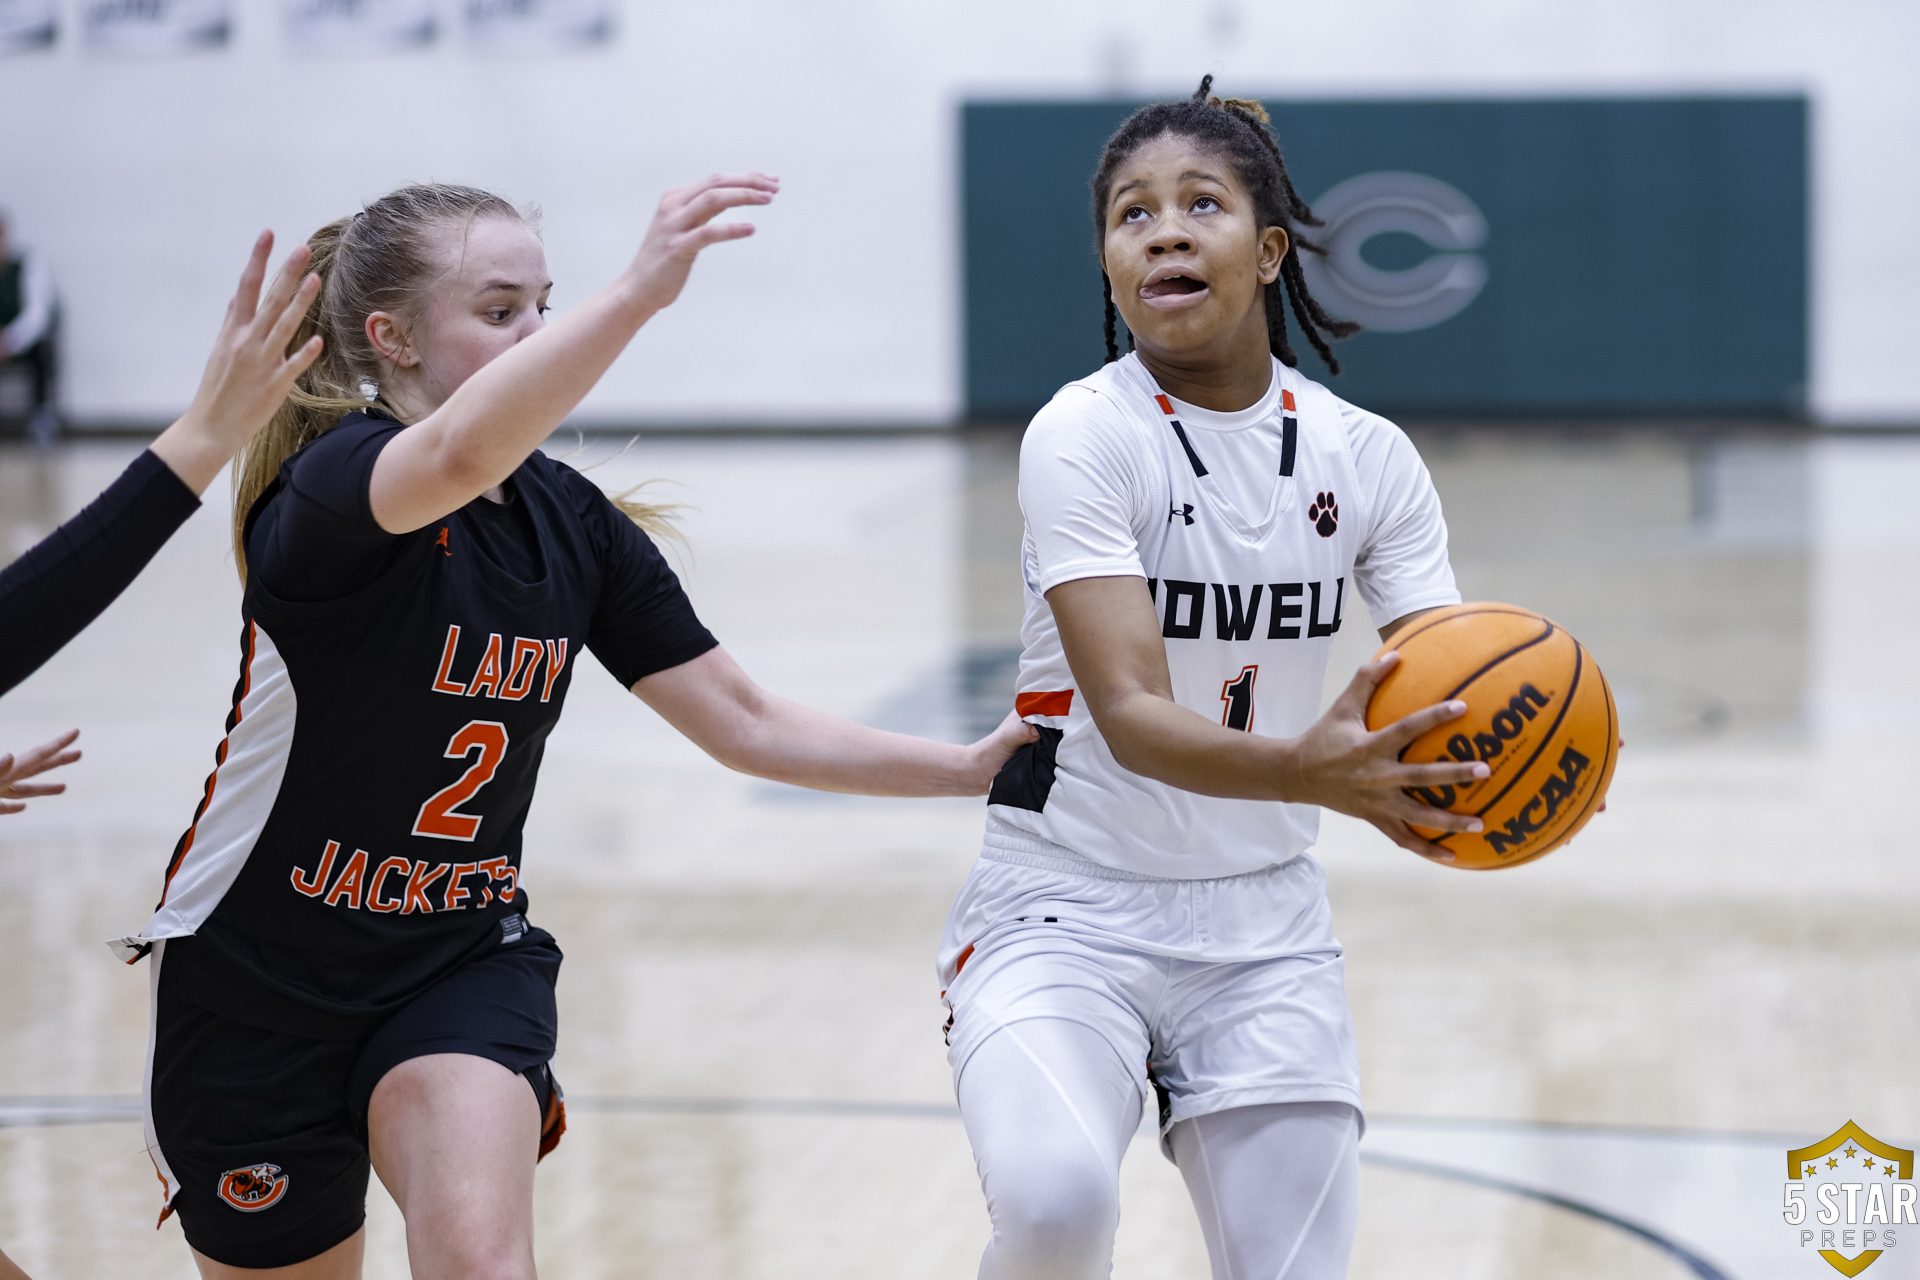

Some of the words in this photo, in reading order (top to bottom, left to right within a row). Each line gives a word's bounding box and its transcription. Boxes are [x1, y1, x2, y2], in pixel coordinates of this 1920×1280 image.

[1296, 170, 1490, 333] C
[1147, 576, 1345, 641] OWELL
[431, 624, 568, 702] LADY
[1220, 664, 1259, 733] 1
[411, 719, 509, 842] 2
[1483, 745, 1590, 855] NCAA
[290, 838, 518, 915] JACKETS
